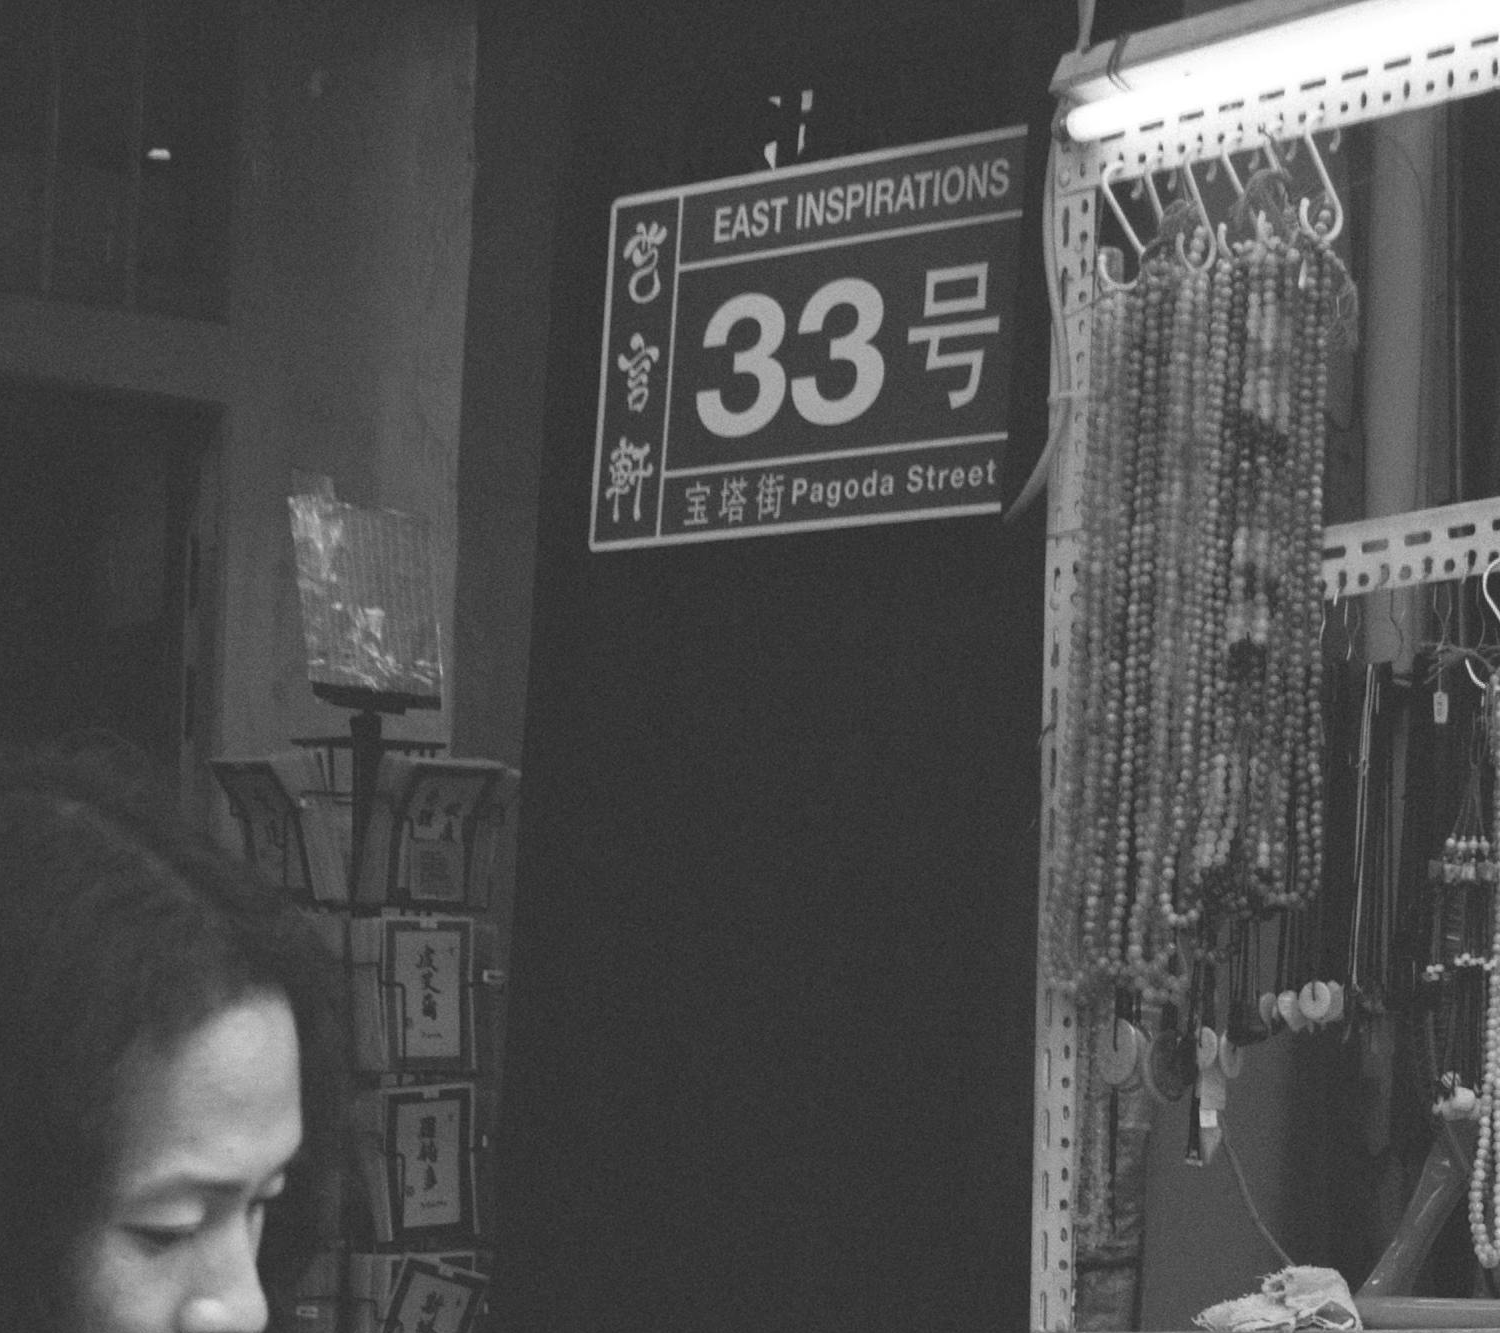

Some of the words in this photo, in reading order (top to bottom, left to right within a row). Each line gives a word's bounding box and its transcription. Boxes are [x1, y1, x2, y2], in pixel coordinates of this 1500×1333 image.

[713, 196, 789, 243] EAST
[795, 158, 1011, 230] INSPIRATIONS
[682, 473, 785, 526] 宝塔街
[791, 470, 895, 509] Pagoda
[906, 459, 996, 494] Street
